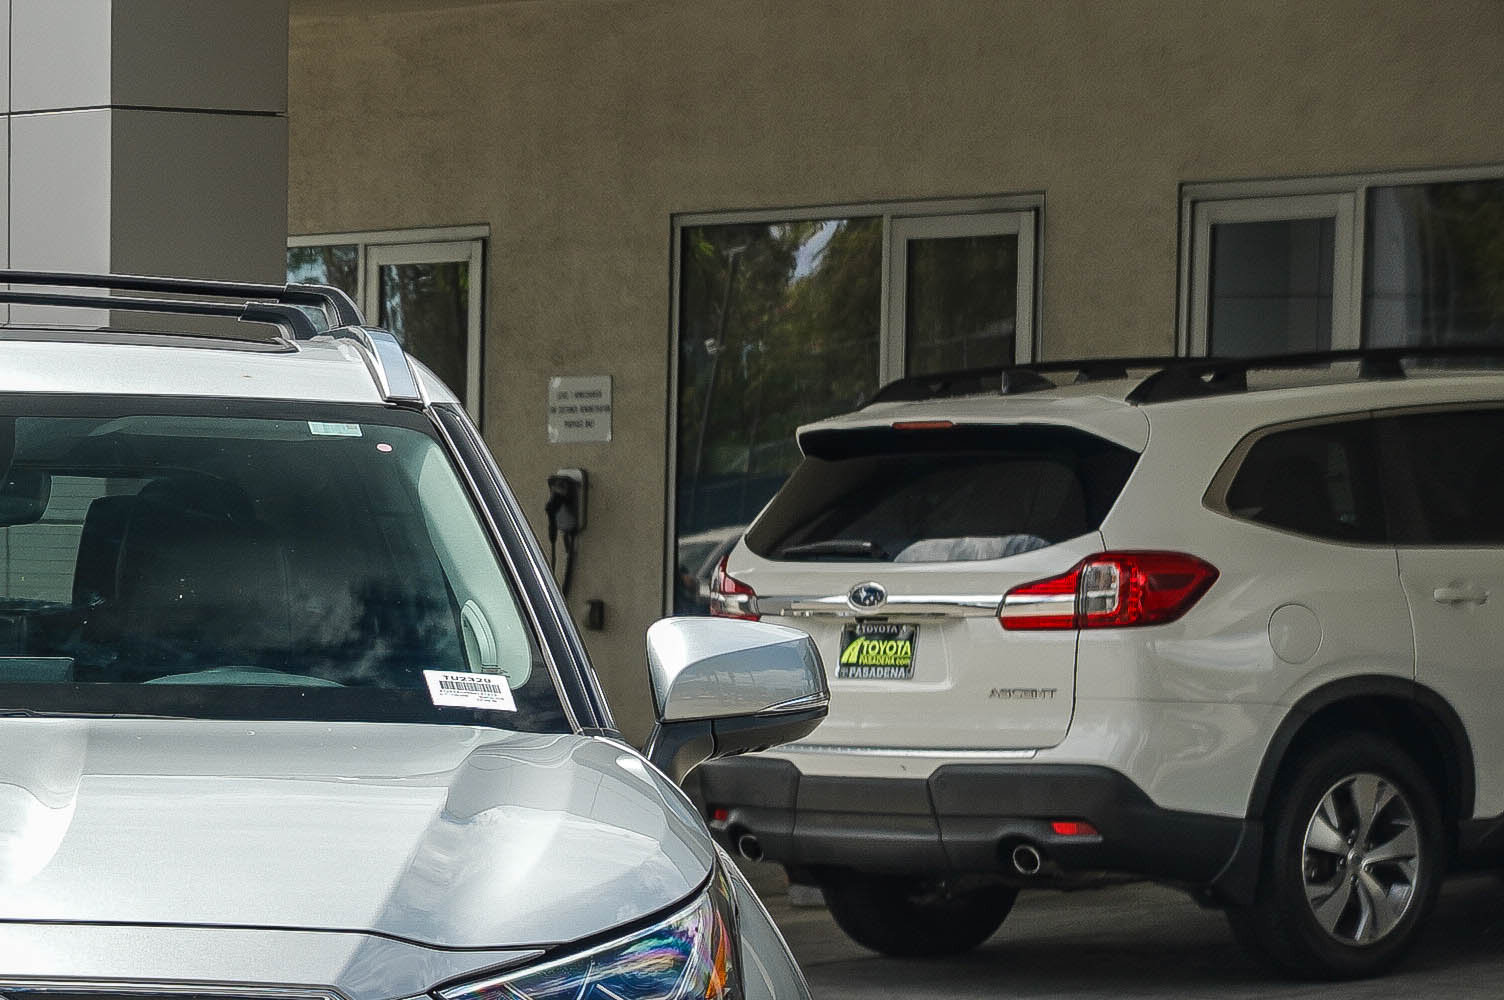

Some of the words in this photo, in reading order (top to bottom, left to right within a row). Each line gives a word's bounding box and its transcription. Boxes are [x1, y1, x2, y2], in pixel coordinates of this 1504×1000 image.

[862, 624, 898, 634] TOYOTA
[862, 640, 911, 657] TOYOTA
[849, 666, 906, 678] PASADENA
